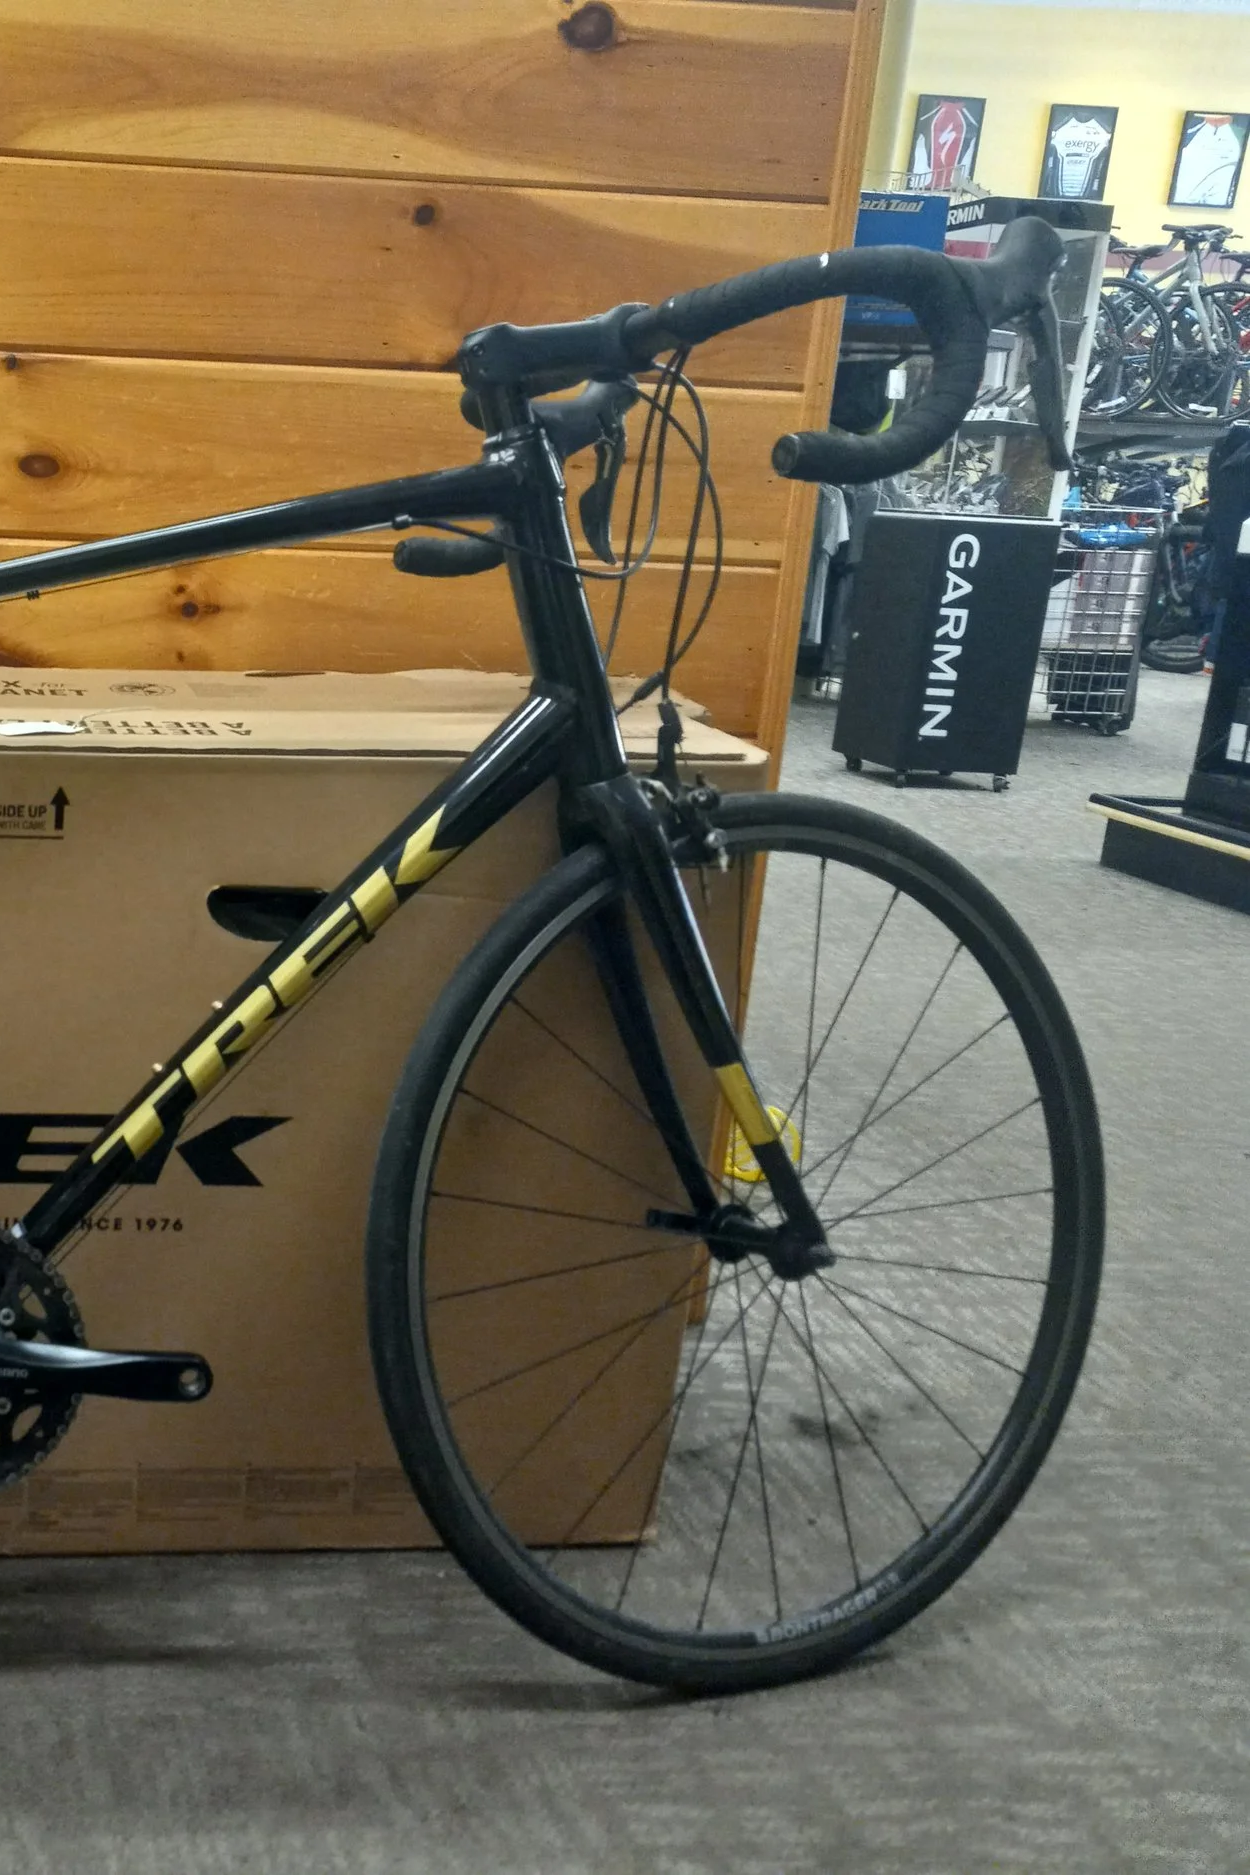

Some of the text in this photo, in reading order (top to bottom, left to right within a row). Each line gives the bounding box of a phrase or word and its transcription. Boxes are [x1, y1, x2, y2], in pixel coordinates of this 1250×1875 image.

[1065, 140, 1100, 153] exergy
[947, 203, 986, 226] RMIN
[918, 533, 981, 738] GARMIN
[28, 804, 48, 819] UP
[91, 803, 462, 1164] TREK
[135, 1217, 183, 1231] 1976
